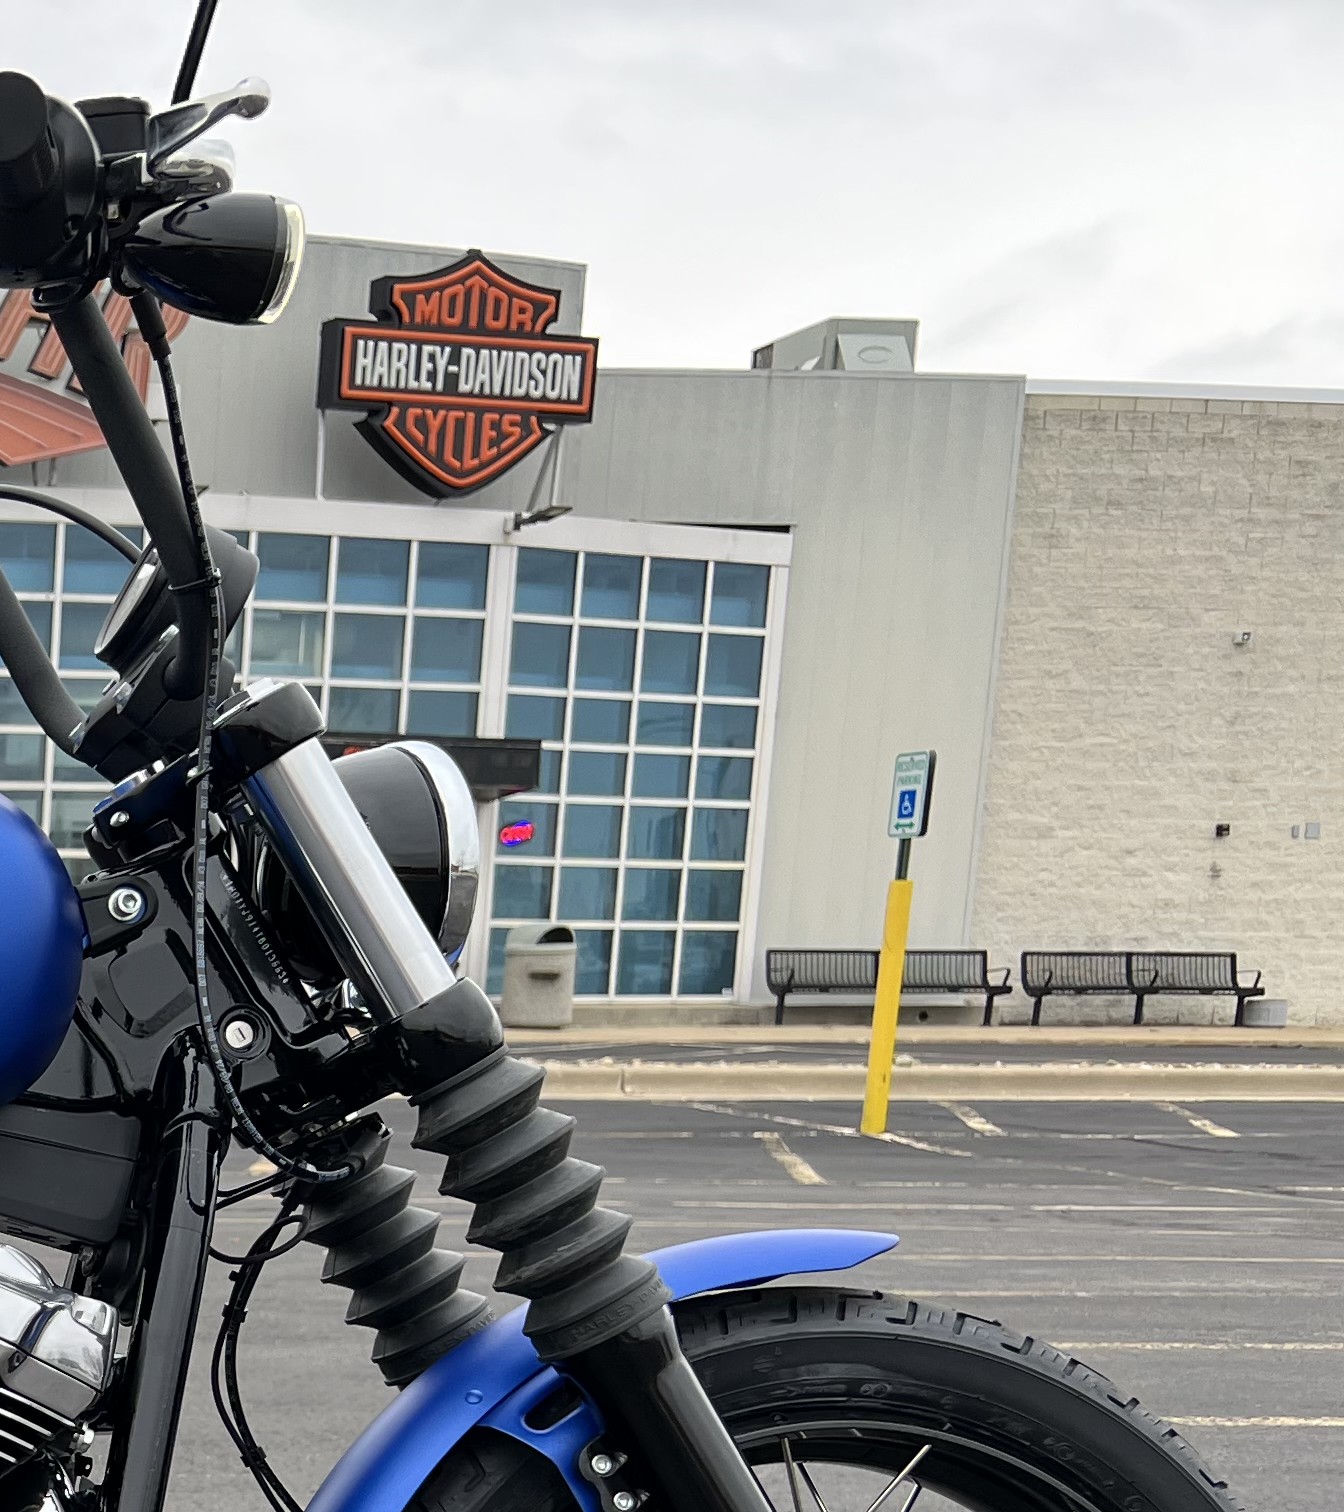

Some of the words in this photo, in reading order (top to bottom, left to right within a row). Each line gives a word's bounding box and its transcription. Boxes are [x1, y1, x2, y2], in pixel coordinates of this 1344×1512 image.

[414, 275, 535, 333] MOTOR
[355, 339, 583, 400] HARLEY-DAVIDSON
[405, 407, 522, 472] CYCLES
